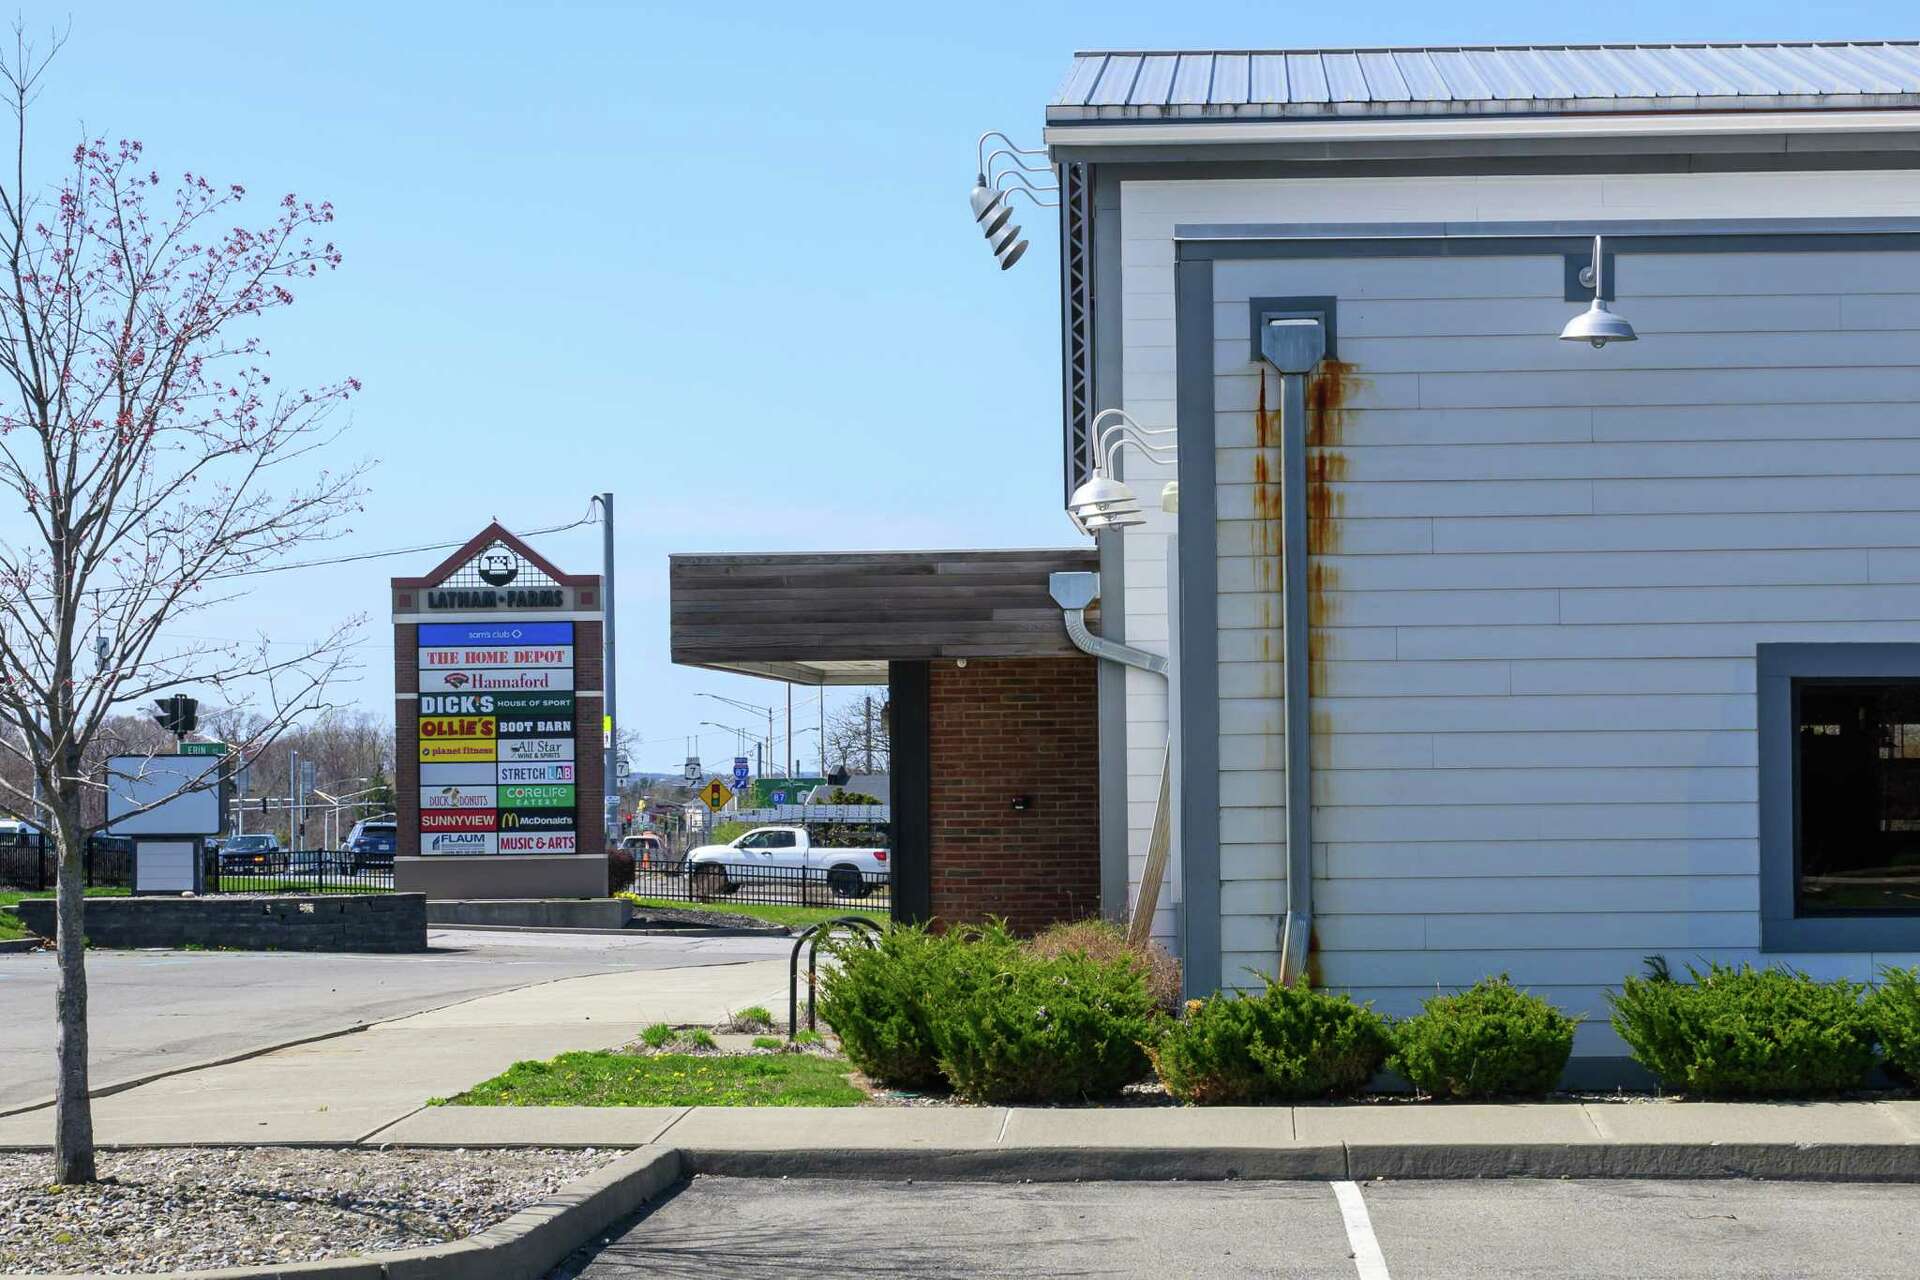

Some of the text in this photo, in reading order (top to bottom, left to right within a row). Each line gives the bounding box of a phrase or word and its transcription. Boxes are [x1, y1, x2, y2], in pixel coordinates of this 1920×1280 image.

[428, 590, 564, 608] LATHAM FARMS
[492, 629, 510, 639] club
[427, 650, 565, 665] THE HOME DEPOT
[472, 672, 549, 689] Hannaford
[421, 696, 494, 714] DICK'S
[500, 721, 571, 732] BOOT BARN
[518, 740, 562, 752] All Star
[502, 766, 571, 780] STRETCH LAB
[618, 765, 625, 774] 7
[689, 767, 696, 777] 7
[429, 795, 488, 806] DUCK DONUTS
[774, 793, 784, 801] 87
[422, 816, 495, 826] SUNNYVIEW
[520, 816, 573, 825] McDonald's
[441, 834, 485, 843] FLAUM
[501, 837, 574, 850] MUSIC & ARTS
